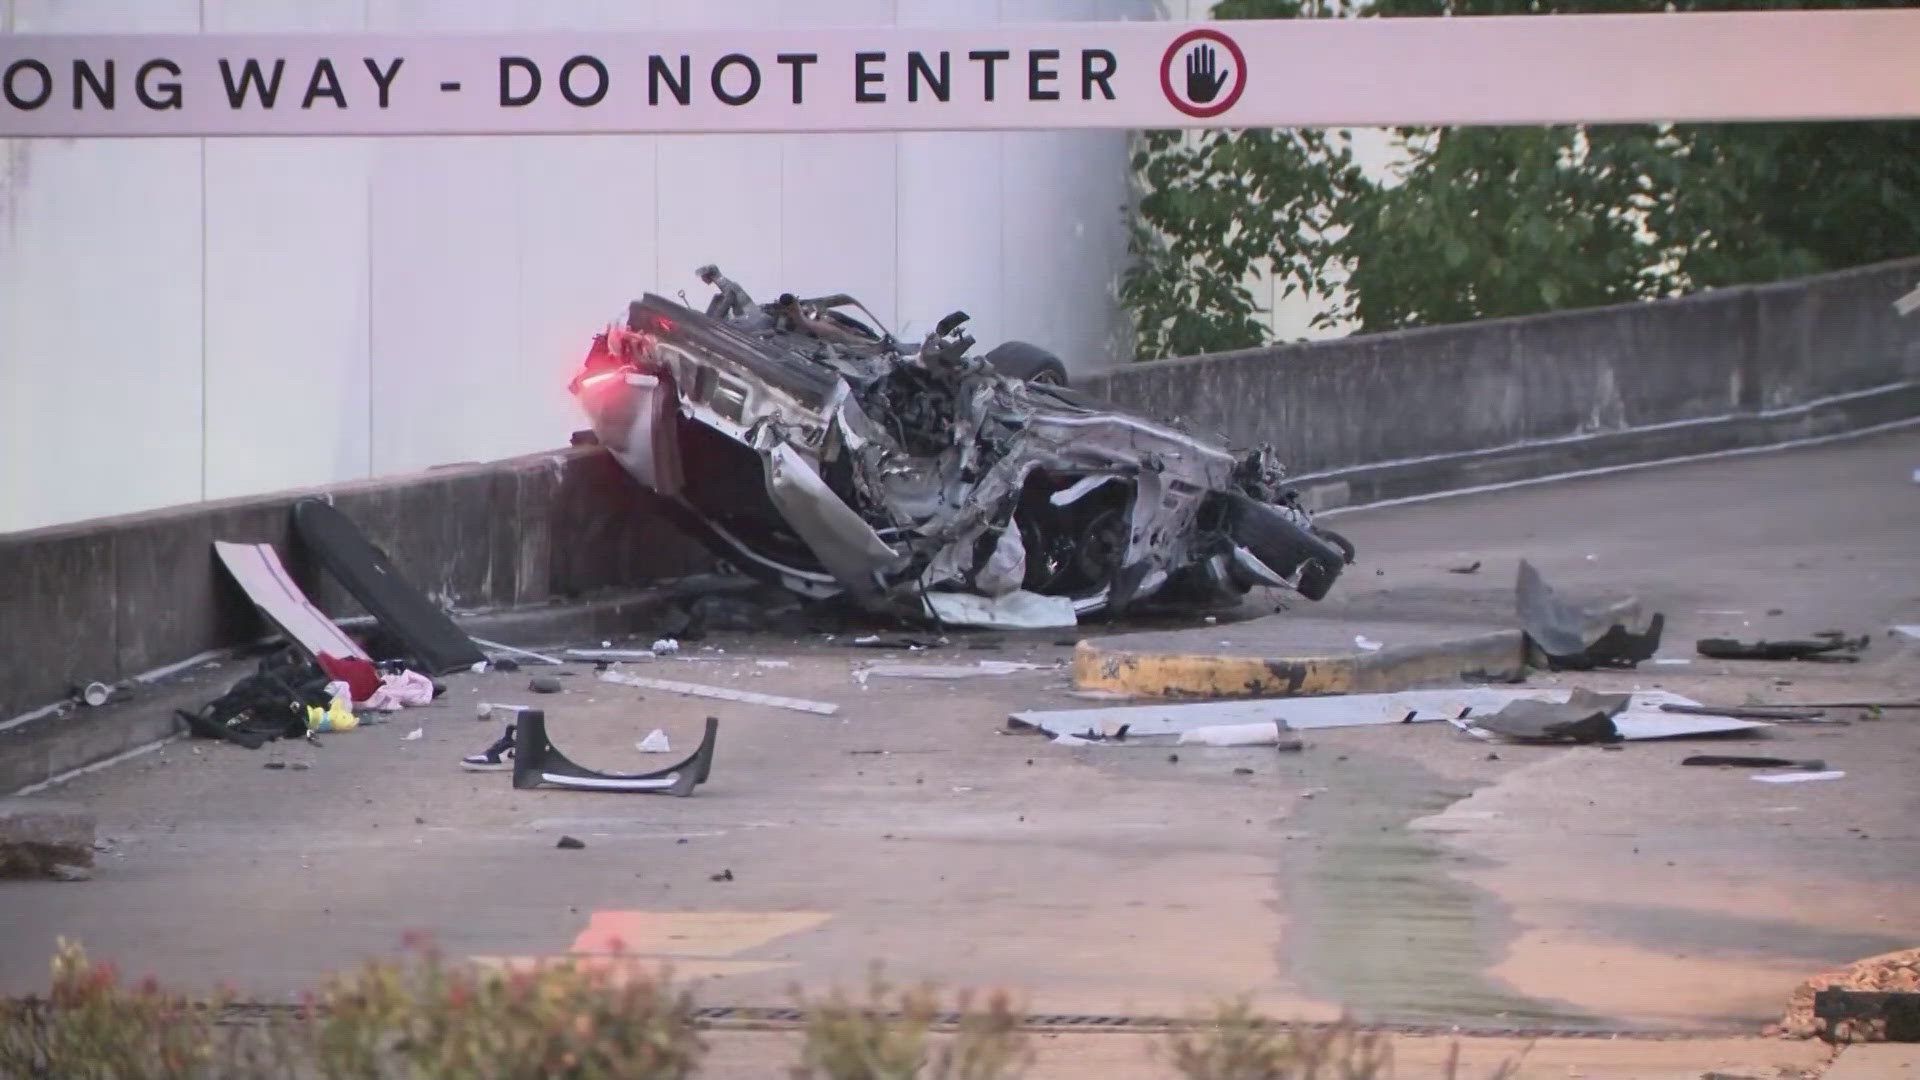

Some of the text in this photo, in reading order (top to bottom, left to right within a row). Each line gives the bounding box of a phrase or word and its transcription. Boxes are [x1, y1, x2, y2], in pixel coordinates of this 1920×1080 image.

[218, 58, 404, 110] WAY
[440, 82, 461, 92] -
[499, 54, 609, 108] DO
[648, 53, 818, 106] NOT
[855, 49, 1117, 103] ENTER
